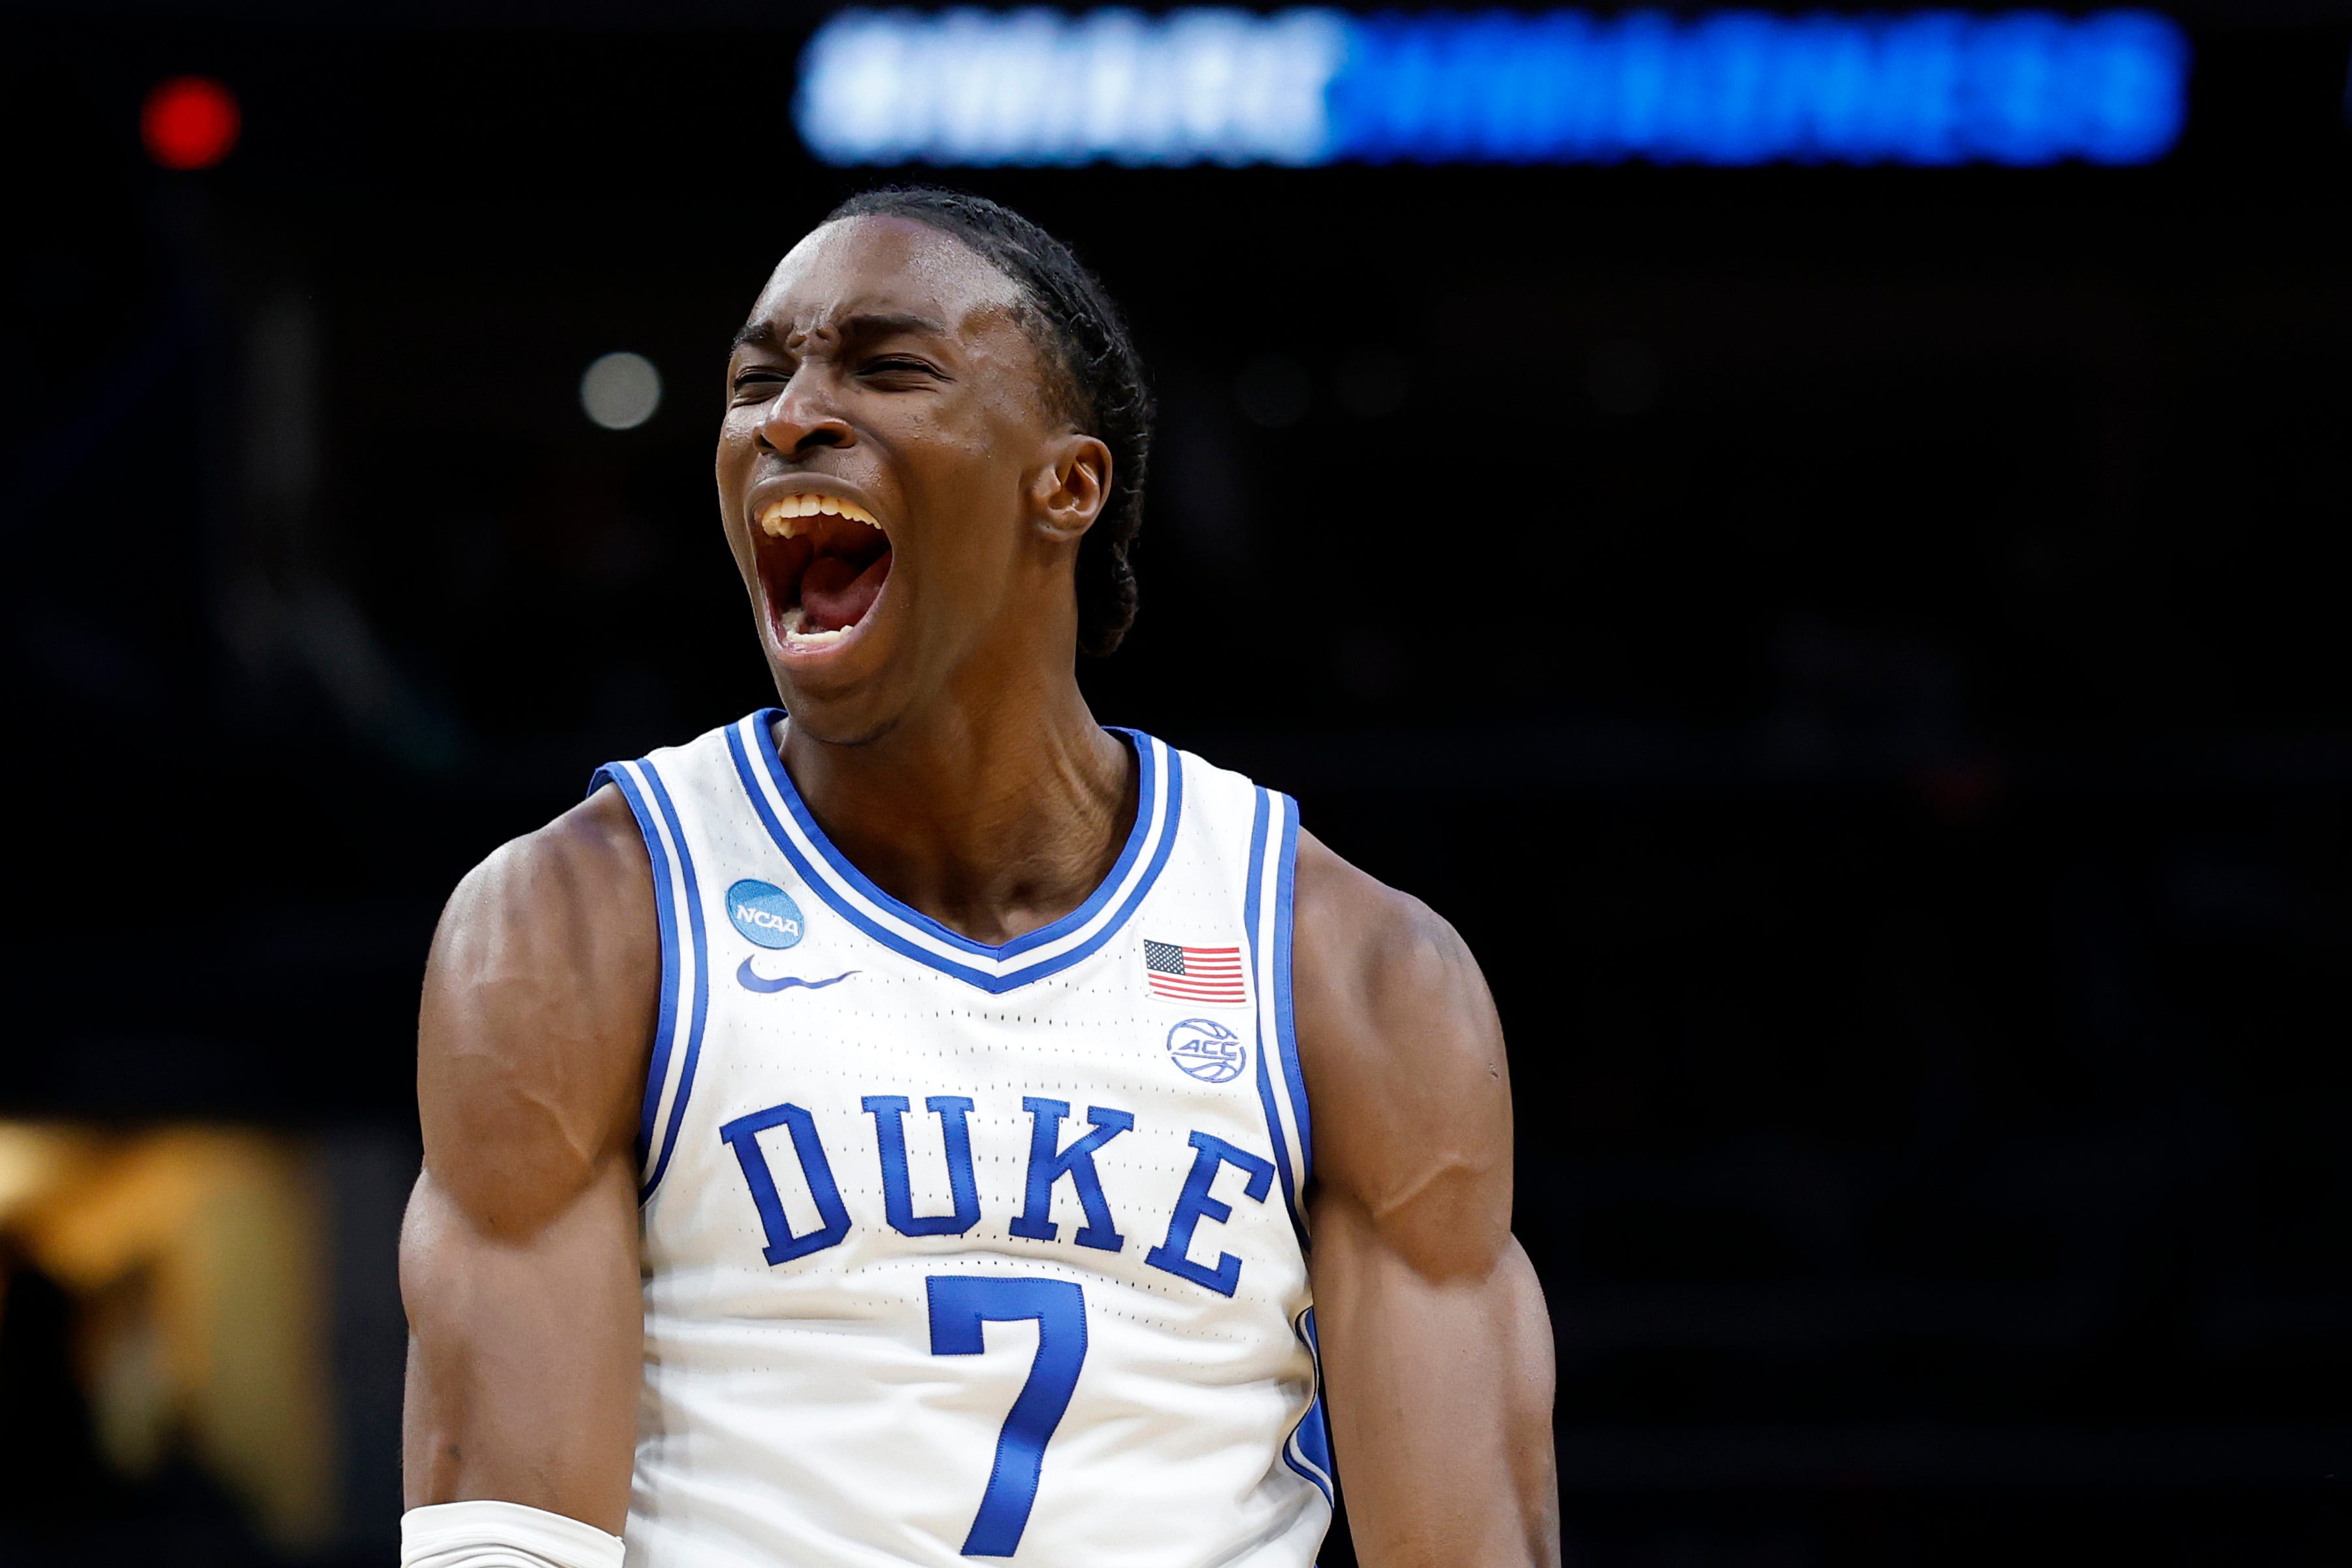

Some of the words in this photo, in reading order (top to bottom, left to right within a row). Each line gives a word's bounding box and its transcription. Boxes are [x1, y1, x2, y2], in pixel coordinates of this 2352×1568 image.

[736, 904, 800, 937] NCAA
[1178, 1039, 1240, 1057] ACC
[720, 1096, 1275, 1298] DUKE
[925, 1275, 1088, 1558] 7
